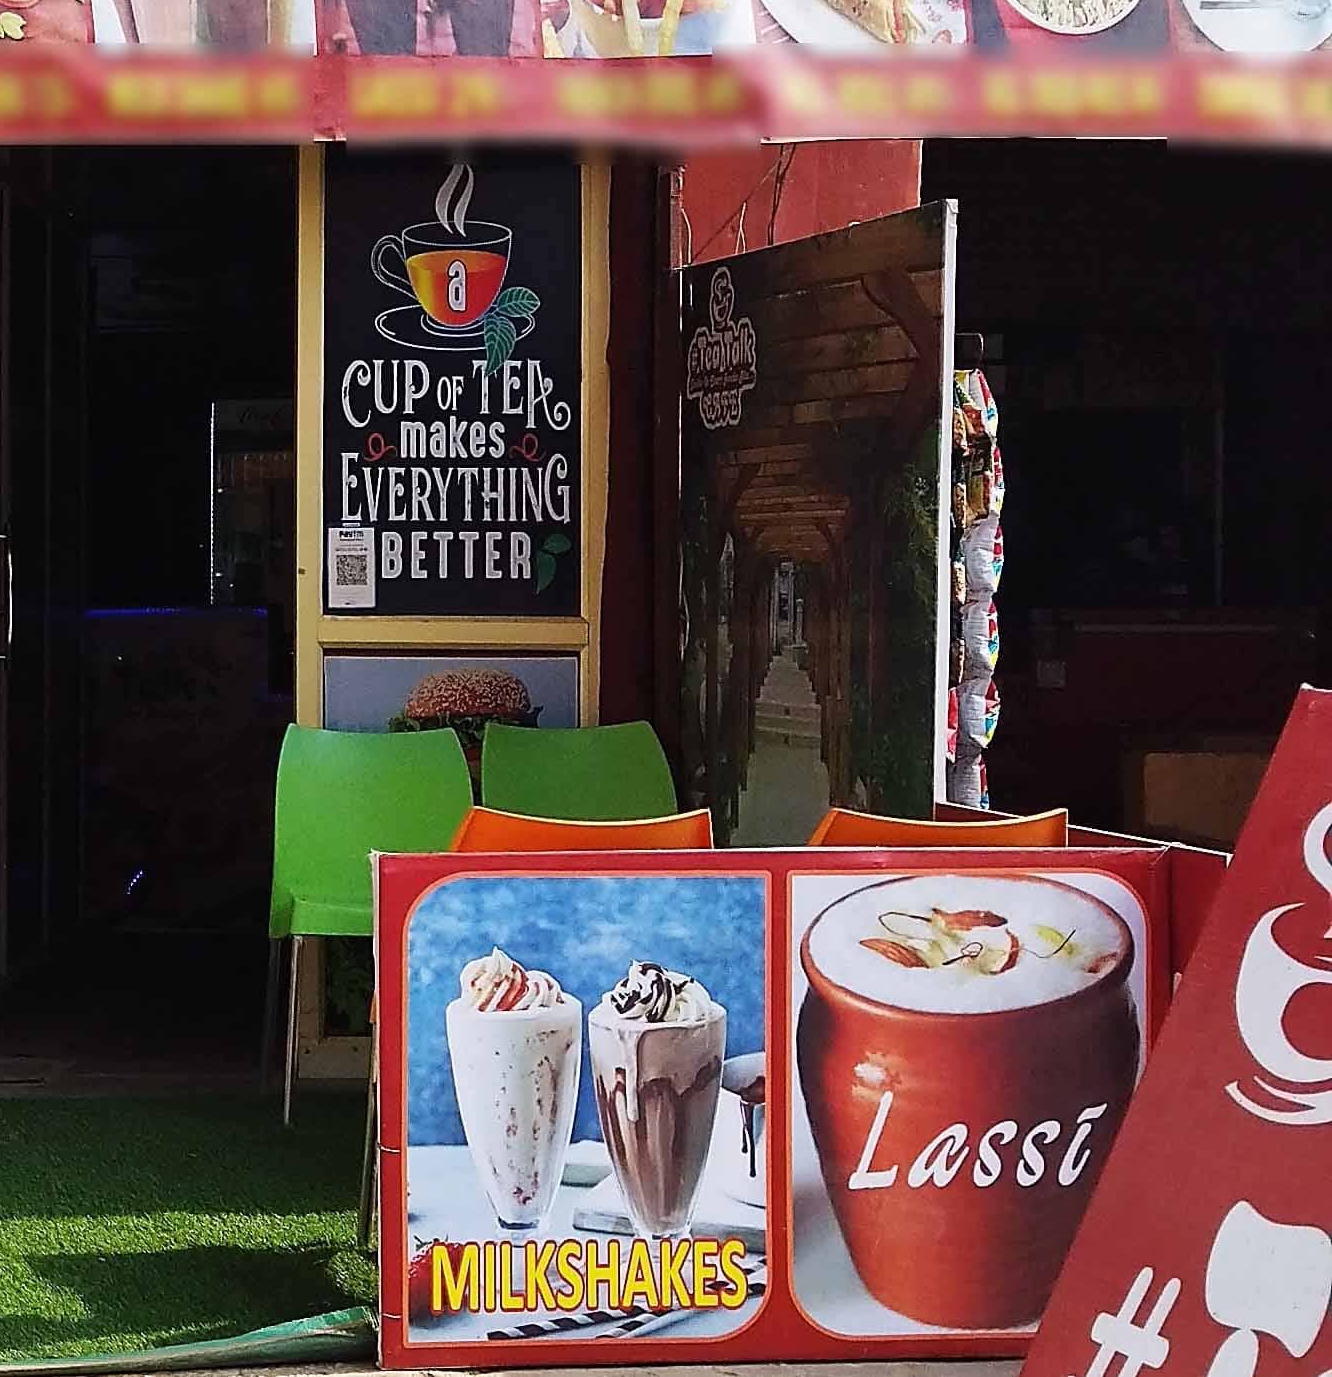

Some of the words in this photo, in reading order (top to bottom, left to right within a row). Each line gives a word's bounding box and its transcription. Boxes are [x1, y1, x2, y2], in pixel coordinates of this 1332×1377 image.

[342, 359, 431, 430] CUP
[437, 376, 465, 410] OF
[472, 359, 572, 431] TEA
[400, 415, 506, 460] makes
[341, 452, 572, 525] EVERYTHING
[380, 531, 532, 579] BETTER
[428, 1237, 749, 1313] MILKSHAKES
